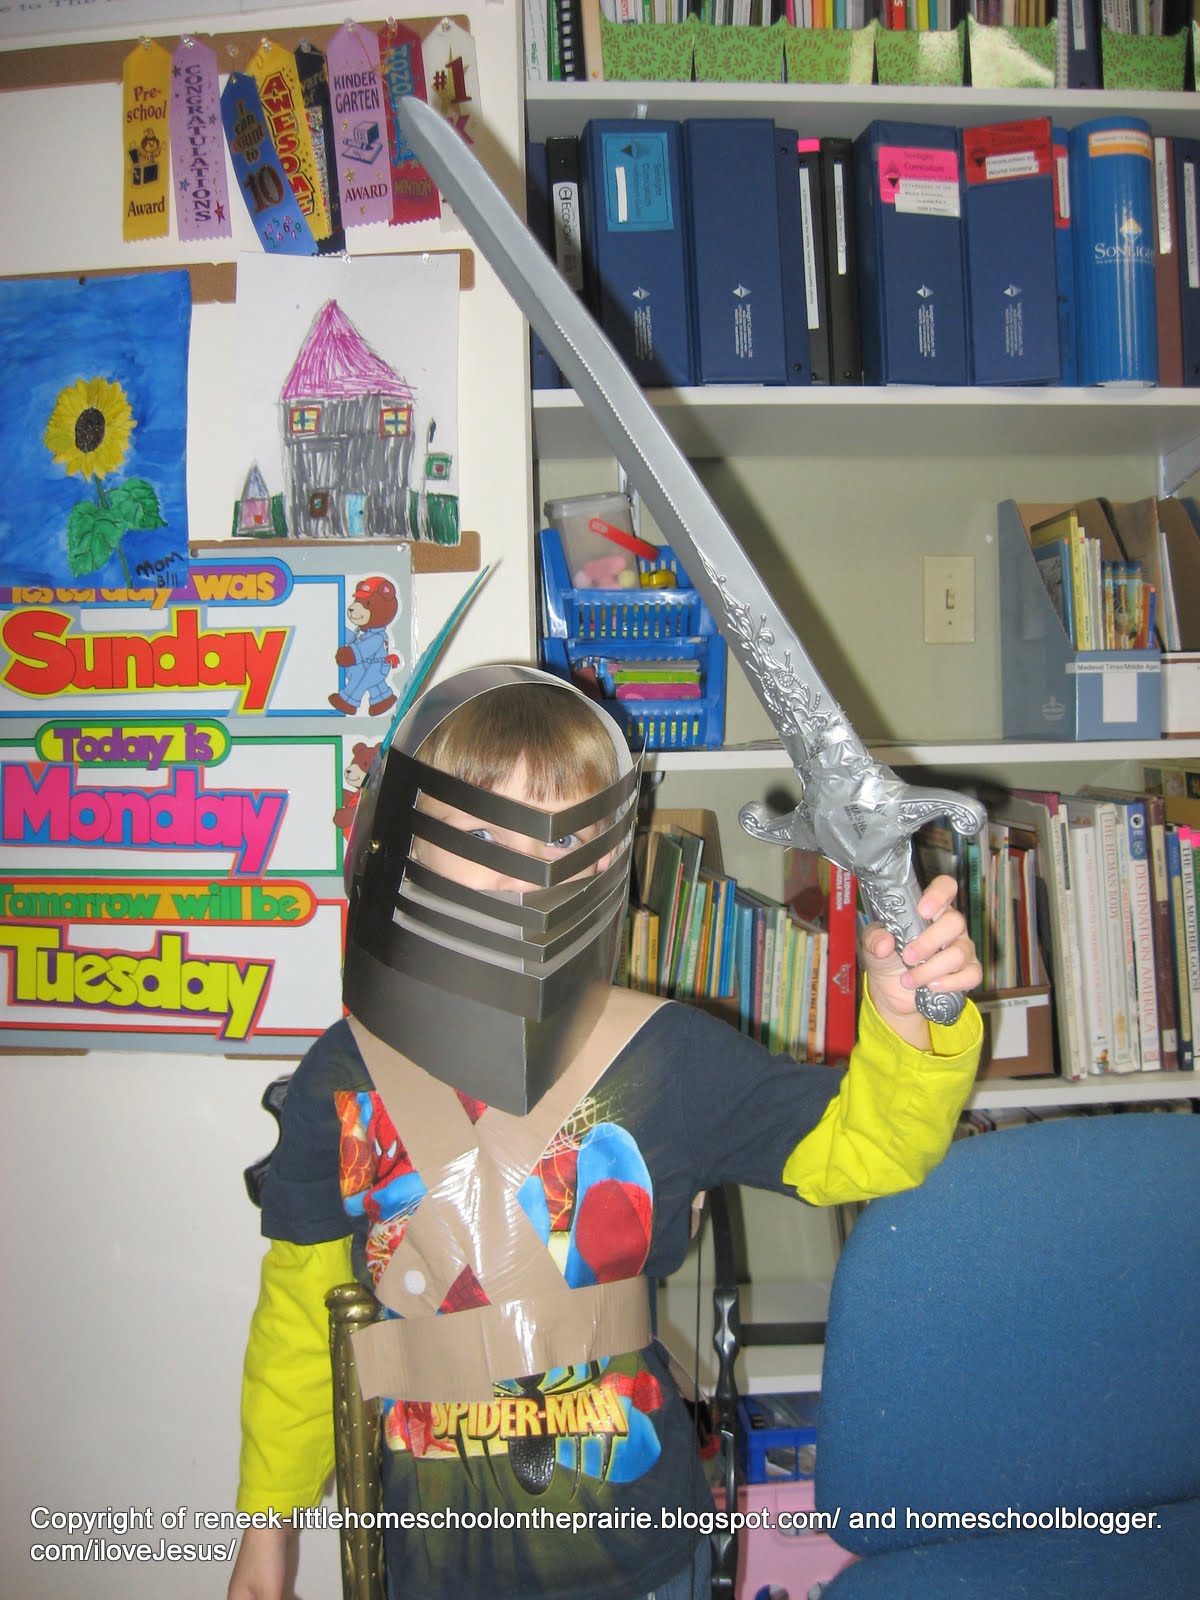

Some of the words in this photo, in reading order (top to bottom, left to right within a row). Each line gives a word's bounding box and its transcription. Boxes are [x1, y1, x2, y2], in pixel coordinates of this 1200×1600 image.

[133, 85, 162, 102] Pre-
[334, 71, 377, 90] KINDER
[126, 101, 168, 123] school
[335, 89, 380, 114] GARTEN
[185, 65, 212, 223] CONGRATULATIONS
[904, 152, 934, 161] Sonlight
[904, 162, 945, 173] Curriculum
[243, 165, 285, 213] 10
[345, 184, 388, 202] AWARD
[127, 196, 165, 218] Award
[1094, 243, 1155, 260] SONLIGH
[191, 572, 276, 601] was
[2, 609, 287, 710] Sunday
[1077, 663, 1104, 671] Medieval
[53, 727, 174, 770] Today
[184, 722, 213, 763] is
[3, 765, 286, 873] Monday
[1103, 816, 1114, 841] THE
[1105, 842, 1117, 888] HUMAN
[1181, 847, 1192, 870] THE
[843, 871, 851, 905] SLIDING
[1184, 873, 1194, 901] REAL
[0, 883, 162, 920] Tomorrow
[172, 882, 243, 921] will
[251, 886, 301, 922] be
[1108, 890, 1120, 920] BODY
[1187, 905, 1197, 952] MOTHER
[1135, 864, 1151, 961] DESTINATION
[1143, 963, 1158, 1034] AMERICA
[0, 926, 269, 1039] Tuesday
[1190, 954, 1200, 993] GOOSE
[432, 1386, 628, 1438] SPIDER-MAN
